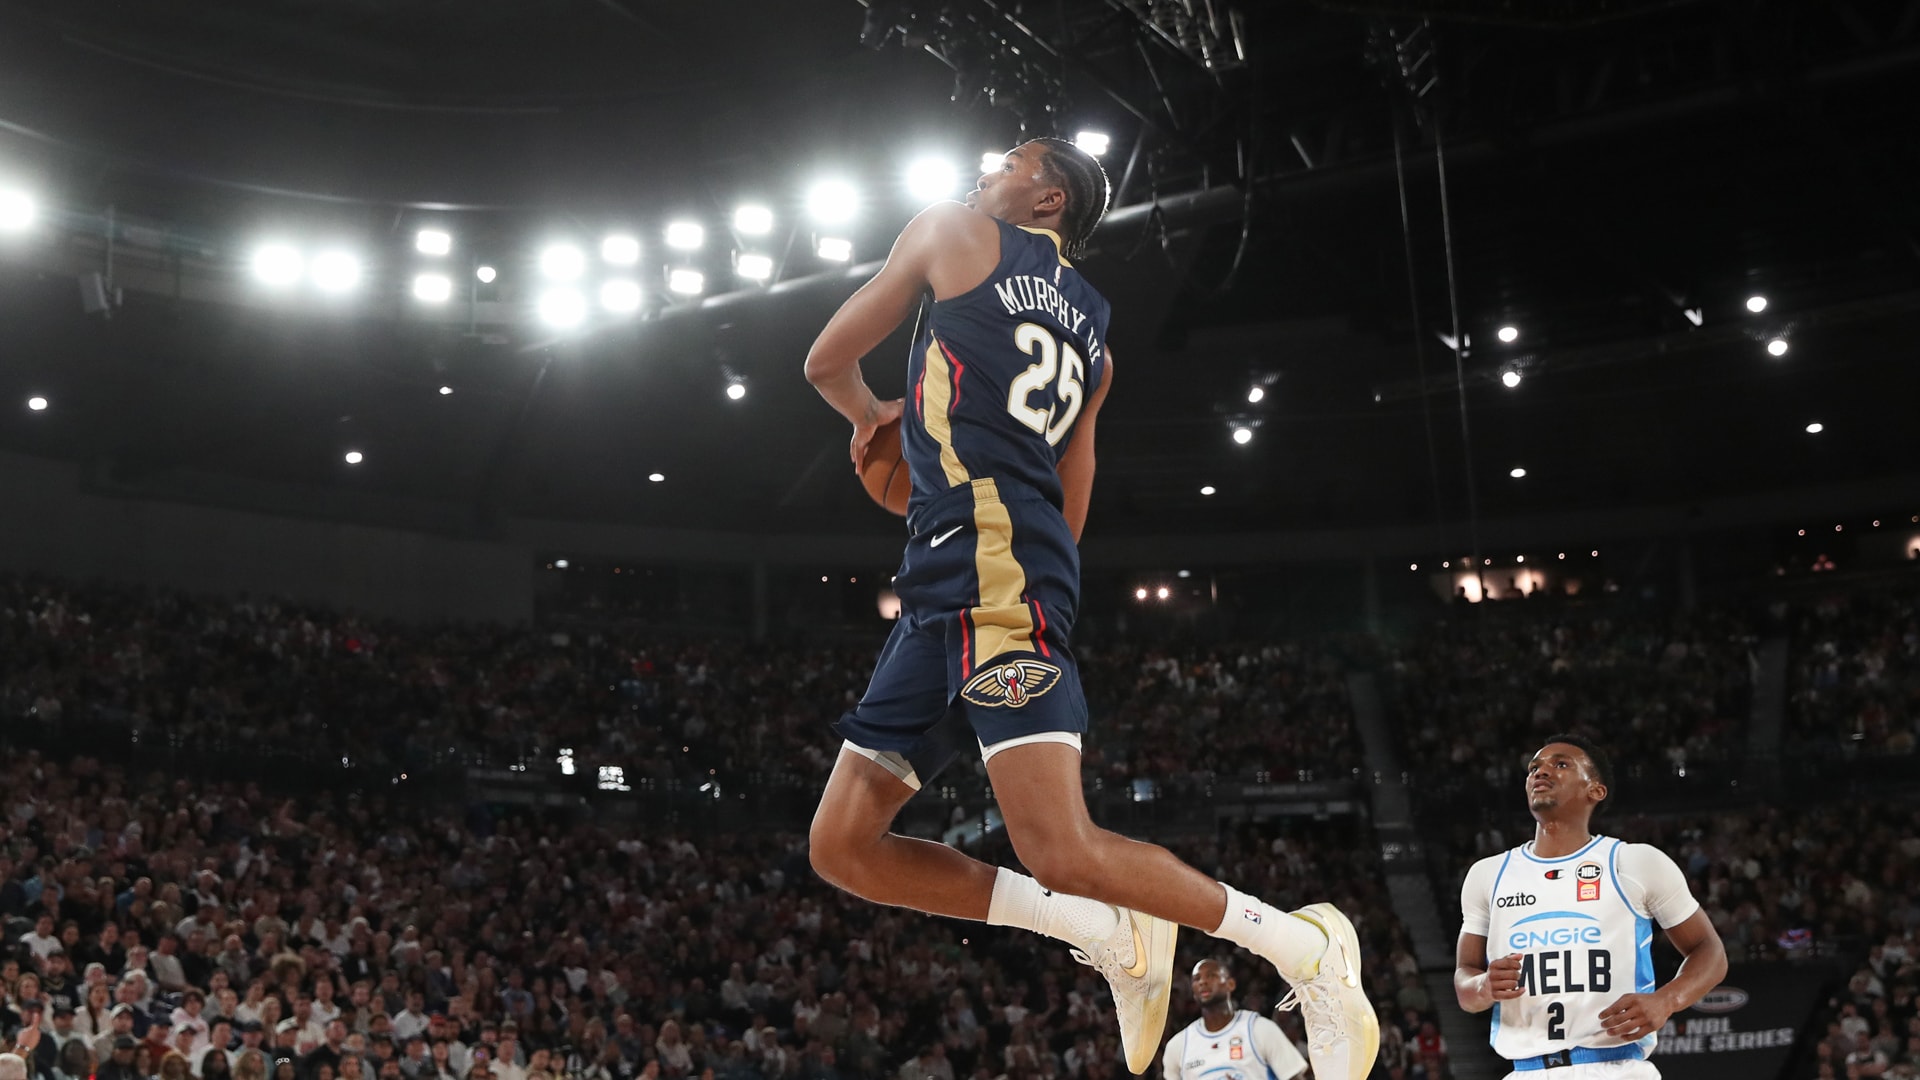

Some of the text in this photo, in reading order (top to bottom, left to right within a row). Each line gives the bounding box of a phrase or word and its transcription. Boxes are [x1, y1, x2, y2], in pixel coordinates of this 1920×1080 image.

[994, 275, 1086, 334] MURPHY
[1007, 322, 1084, 447] 25
[1581, 866, 1598, 878] NBL
[1497, 892, 1537, 908] ozito
[1547, 1002, 1565, 1040] 2
[1708, 1027, 1795, 1052] SERIES
